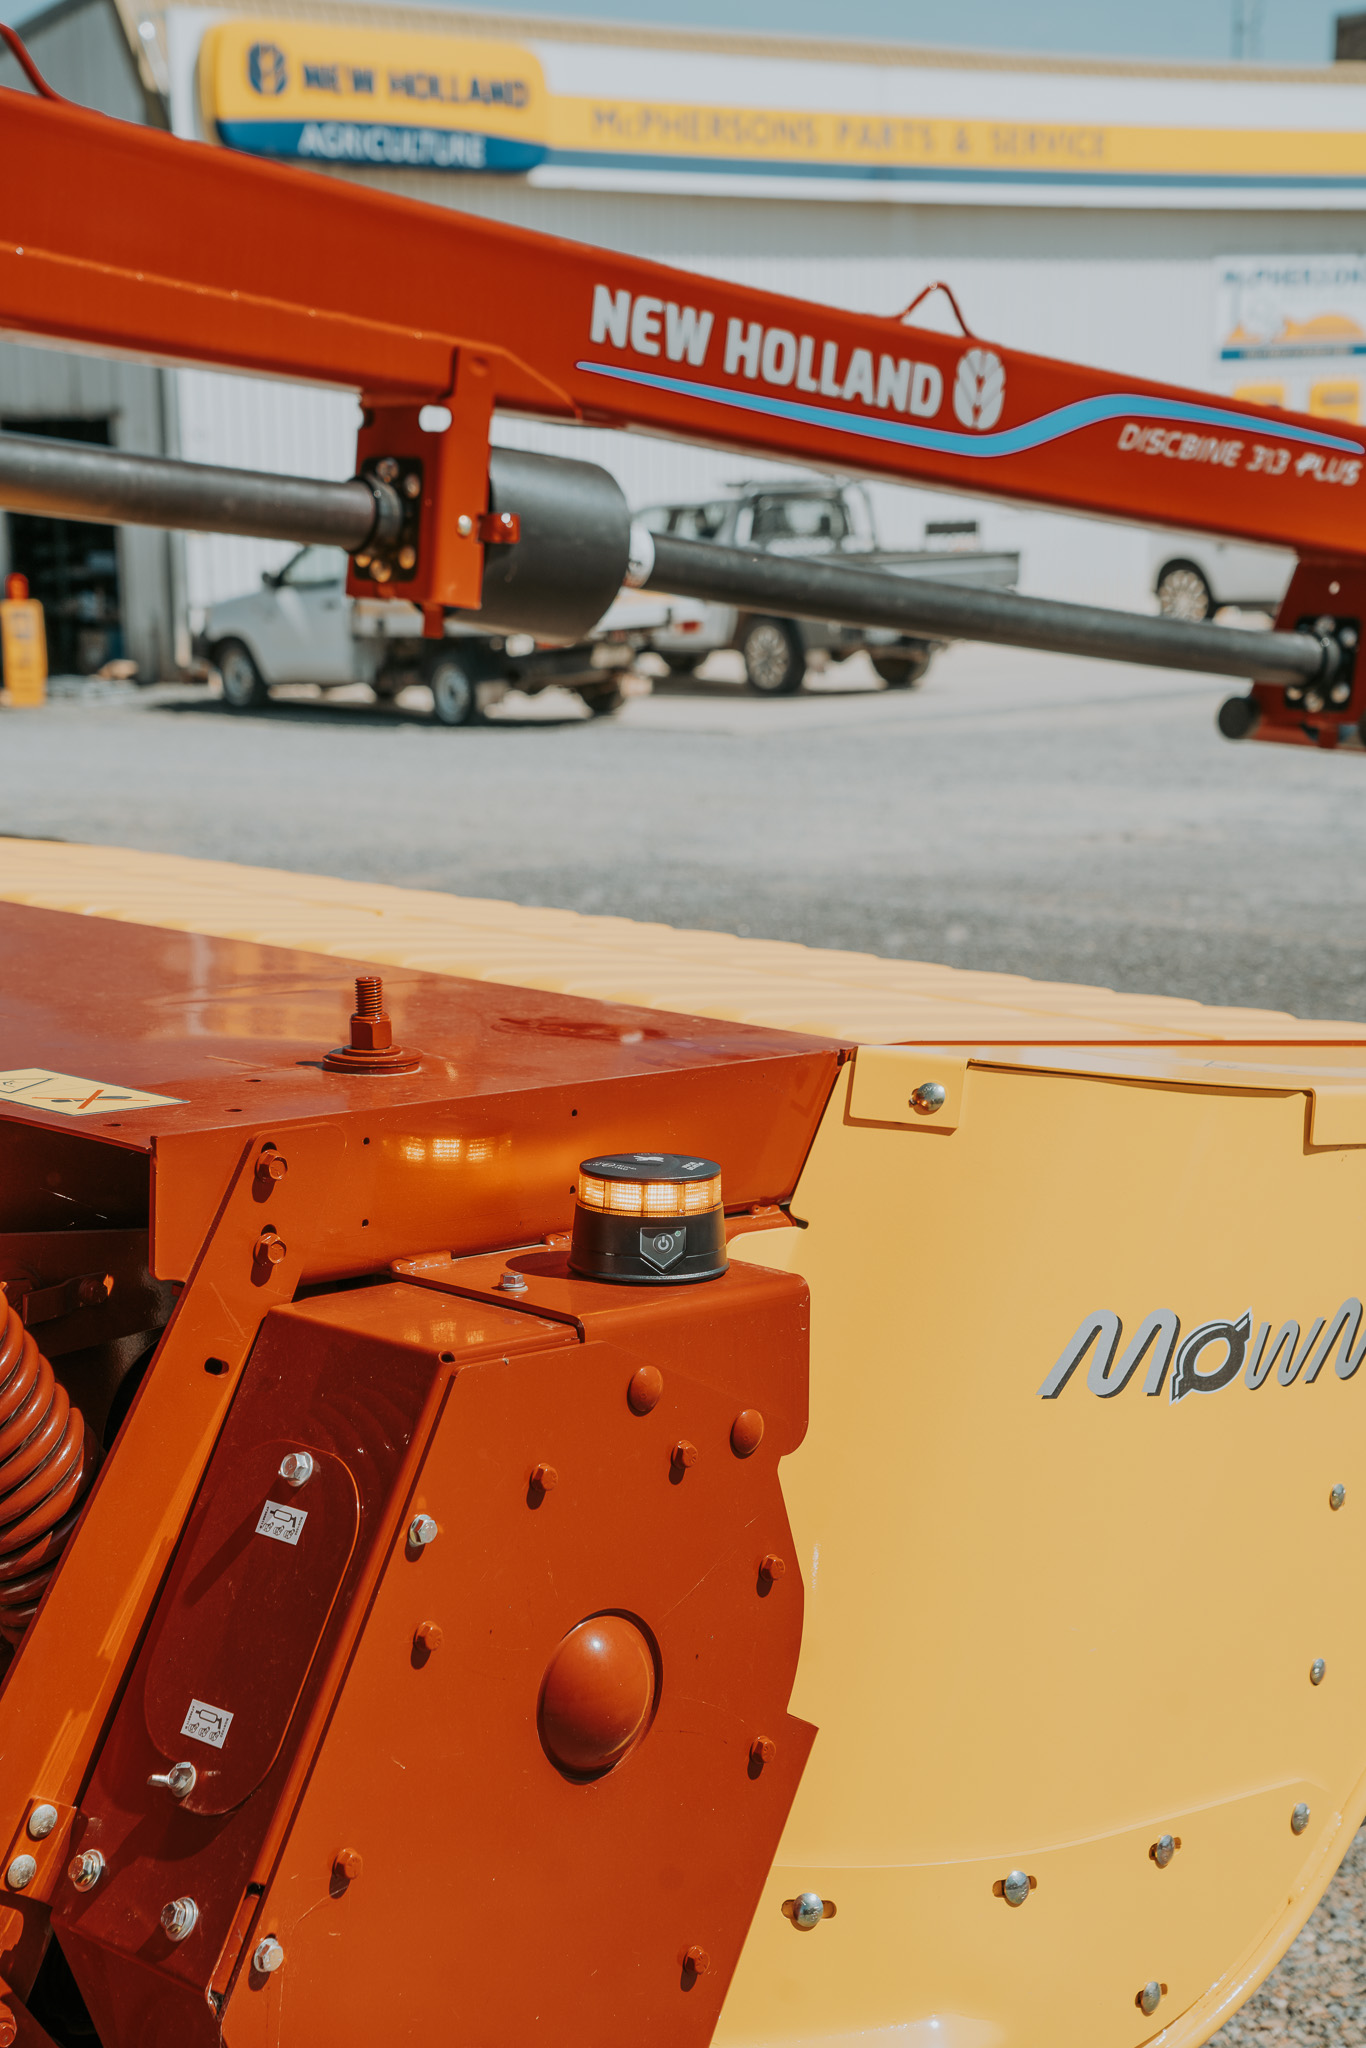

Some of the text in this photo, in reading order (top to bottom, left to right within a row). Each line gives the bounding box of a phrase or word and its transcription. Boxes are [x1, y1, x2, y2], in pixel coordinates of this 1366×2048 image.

[304, 65, 529, 109] NEW HOLLAND
[297, 123, 486, 168] AGRICULTURE
[837, 119, 936, 155] PARTS
[954, 126, 971, 154] &
[989, 126, 1107, 160] SERVICE
[590, 284, 943, 419] NEW HOLLAND
[1117, 423, 1364, 487] DISCBINE 313 PLUS
